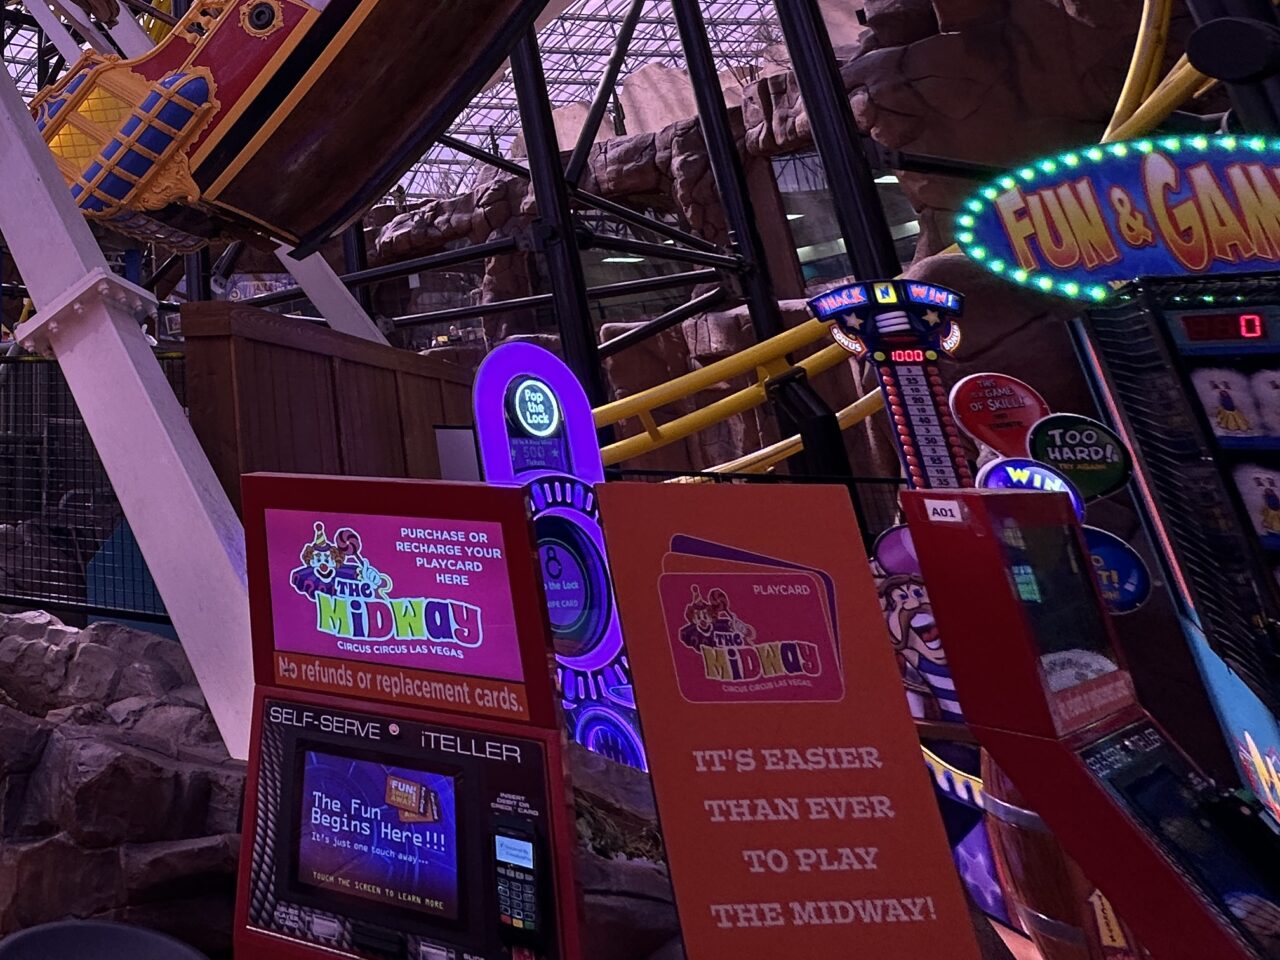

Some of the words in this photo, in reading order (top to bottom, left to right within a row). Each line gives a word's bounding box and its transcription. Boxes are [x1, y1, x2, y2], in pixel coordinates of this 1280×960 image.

[995, 176, 1119, 272] FUN
[1109, 184, 1155, 246] &
[813, 288, 866, 313] WHACK
[878, 286, 891, 299] N
[910, 284, 953, 307] WIN!
[832, 327, 862, 352] BONUS
[891, 350, 924, 362] 1000
[524, 389, 544, 404] Pop
[985, 387, 1014, 398] GAME
[527, 402, 545, 413] the
[970, 401, 983, 411] OF
[526, 411, 550, 424] Lock
[1047, 428, 1098, 445] TOO
[523, 446, 545, 459] 500
[1047, 444, 1114, 463] HARD!
[932, 507, 956, 518] A01
[400, 527, 466, 542] PURCHASE
[469, 532, 488, 543] OR
[395, 541, 463, 556] RECHARGE
[464, 546, 502, 559] YOUR
[415, 557, 483, 572] PLAYCARD
[435, 573, 470, 586] HERE
[752, 584, 810, 595] PLAYCARD
[337, 640, 371, 654] CIRCUS
[374, 644, 408, 654] CIRCUS
[410, 645, 428, 654] LAS
[431, 645, 464, 659] VEGAS
[278, 656, 298, 679] No
[302, 662, 353, 689] refunds
[357, 673, 371, 689] or
[376, 674, 471, 706] replacement
[475, 686, 524, 713] cards.
[722, 684, 748, 693] CIRCUS
[775, 680, 788, 688] LAS
[789, 679, 813, 688] VEGAS
[269, 706, 381, 740] SELF-SERVE
[421, 731, 521, 763] iTELLER
[692, 748, 756, 772] IT'S
[761, 746, 883, 771] EASIER
[497, 797, 517, 806] DEBIT
[500, 792, 525, 801] INSERT
[313, 791, 341, 811] The
[351, 799, 381, 820] Fun
[517, 807, 539, 816] CARD
[703, 797, 799, 822] THAN
[805, 795, 895, 820] EVER
[311, 807, 370, 835] Begins
[381, 822, 445, 851] Here!!!
[312, 832, 330, 843] It's
[333, 836, 351, 848] just
[354, 842, 368, 852] one
[372, 846, 396, 858] touch
[398, 853, 429, 865] away...
[742, 848, 788, 873] TO
[794, 847, 879, 872] PLAY
[313, 871, 334, 883] TOUCH
[338, 877, 351, 888] THE
[354, 881, 381, 895] SCREEN
[385, 888, 395, 898] TO
[398, 892, 422, 904] LEARN
[425, 899, 444, 910] MORE
[710, 903, 785, 928] THE
[789, 895, 937, 926] MIDWAY!
